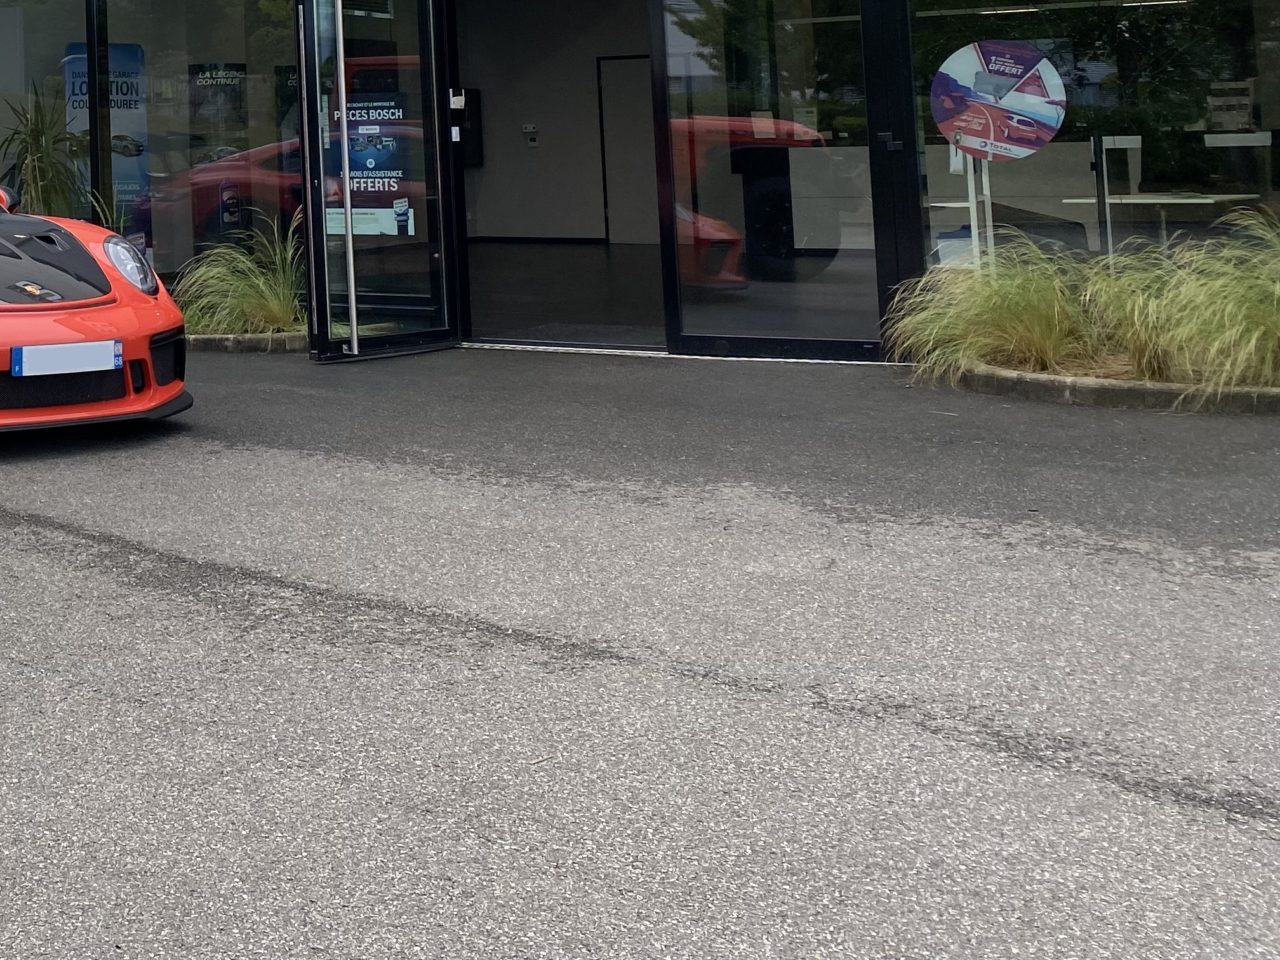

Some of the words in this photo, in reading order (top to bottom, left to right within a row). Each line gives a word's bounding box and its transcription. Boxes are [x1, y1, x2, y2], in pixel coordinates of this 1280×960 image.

[988, 64, 1024, 75] OFFERT
[196, 78, 240, 86] CONTINUE
[369, 109, 403, 120] BOSCH
[114, 356, 123, 366] 68
